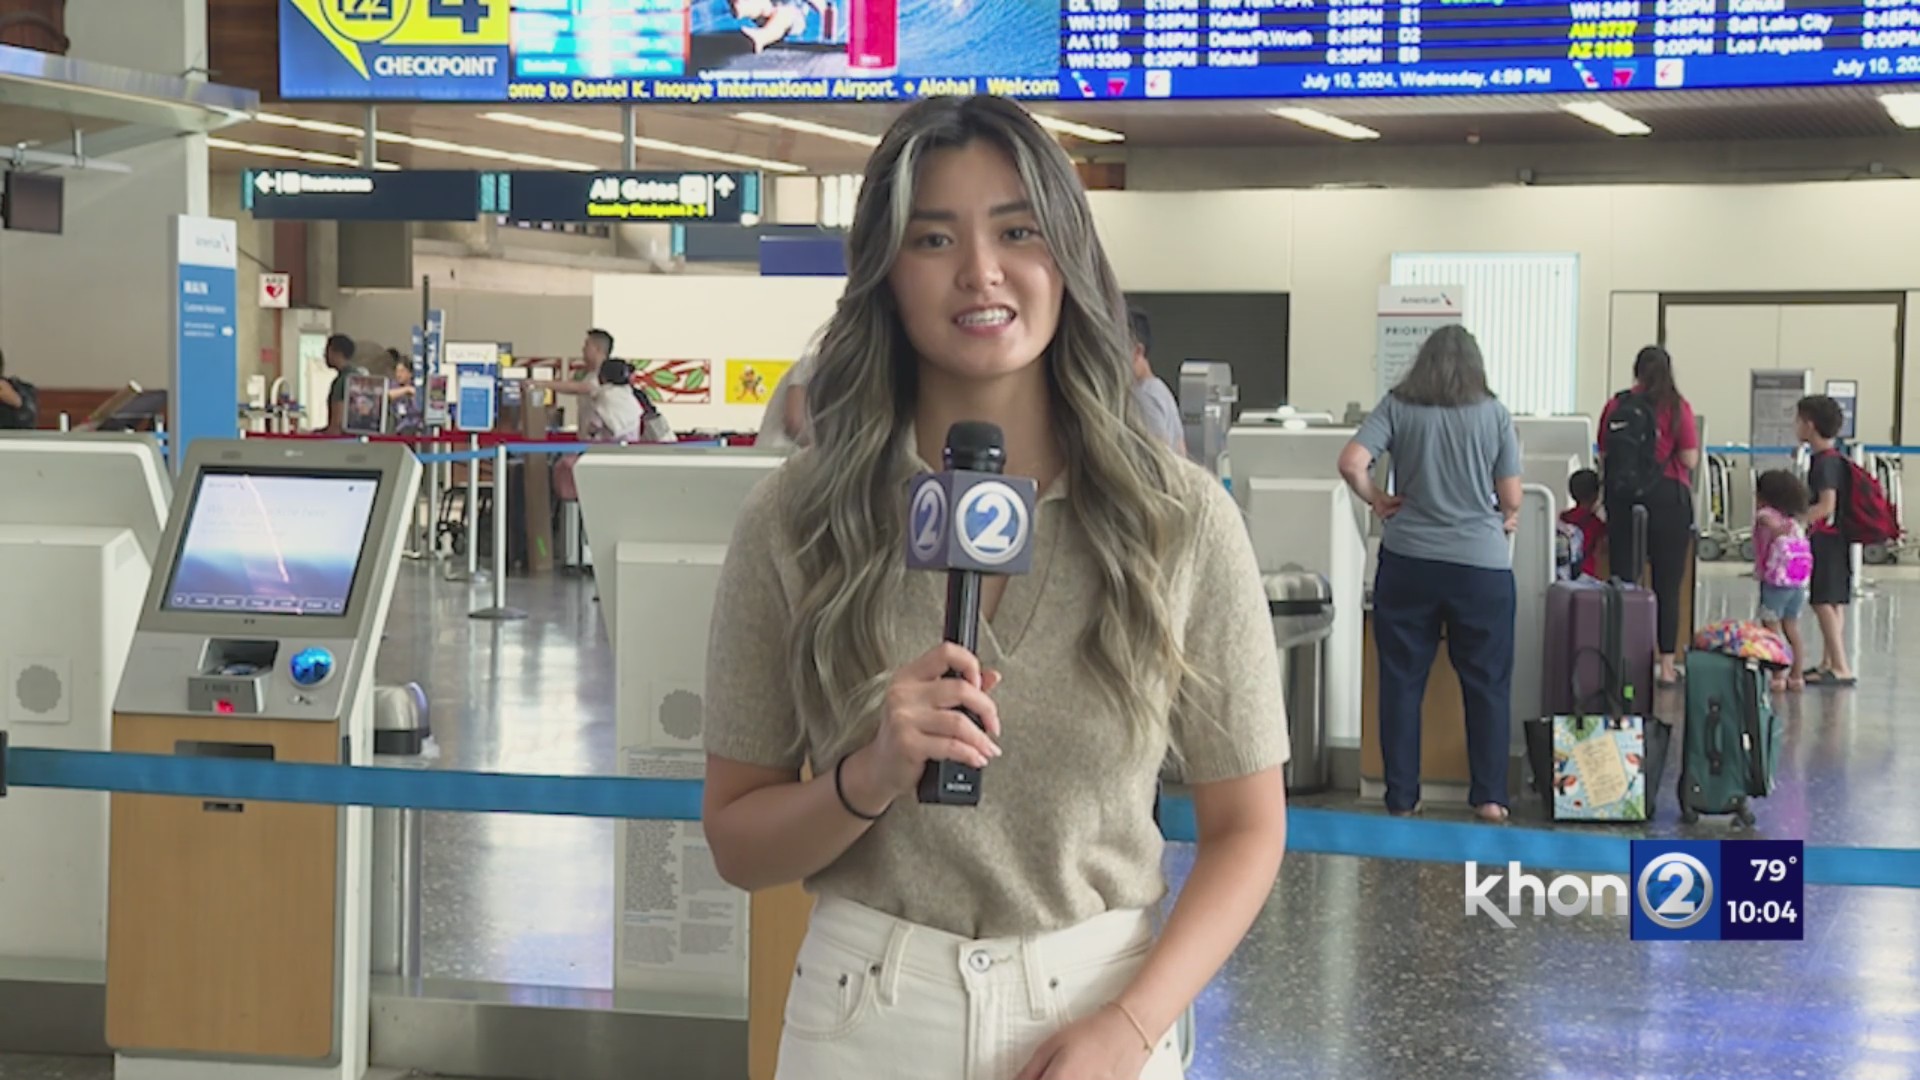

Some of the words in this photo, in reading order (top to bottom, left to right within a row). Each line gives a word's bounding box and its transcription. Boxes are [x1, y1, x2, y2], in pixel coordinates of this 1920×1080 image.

[1569, 22, 1596, 38] AM
[1067, 35, 1090, 49] AA
[1568, 42, 1592, 58] AZ
[1727, 38, 1757, 54] Los
[1758, 35, 1823, 54] Angeles
[375, 57, 496, 75] CHECKPOINT
[1833, 60, 1865, 77] July
[918, 78, 976, 97] Aloha!
[1303, 74, 1330, 90] July
[1526, 68, 1551, 83] PM
[550, 82, 568, 98] to
[572, 80, 627, 98] Daniel
[632, 81, 649, 97] K.
[655, 81, 713, 101] Inouye
[717, 79, 828, 97] International
[832, 79, 898, 99] Airport.
[590, 179, 619, 199] All
[621, 179, 679, 200] Gates
[918, 490, 940, 545] 2
[971, 492, 1011, 549] 2
